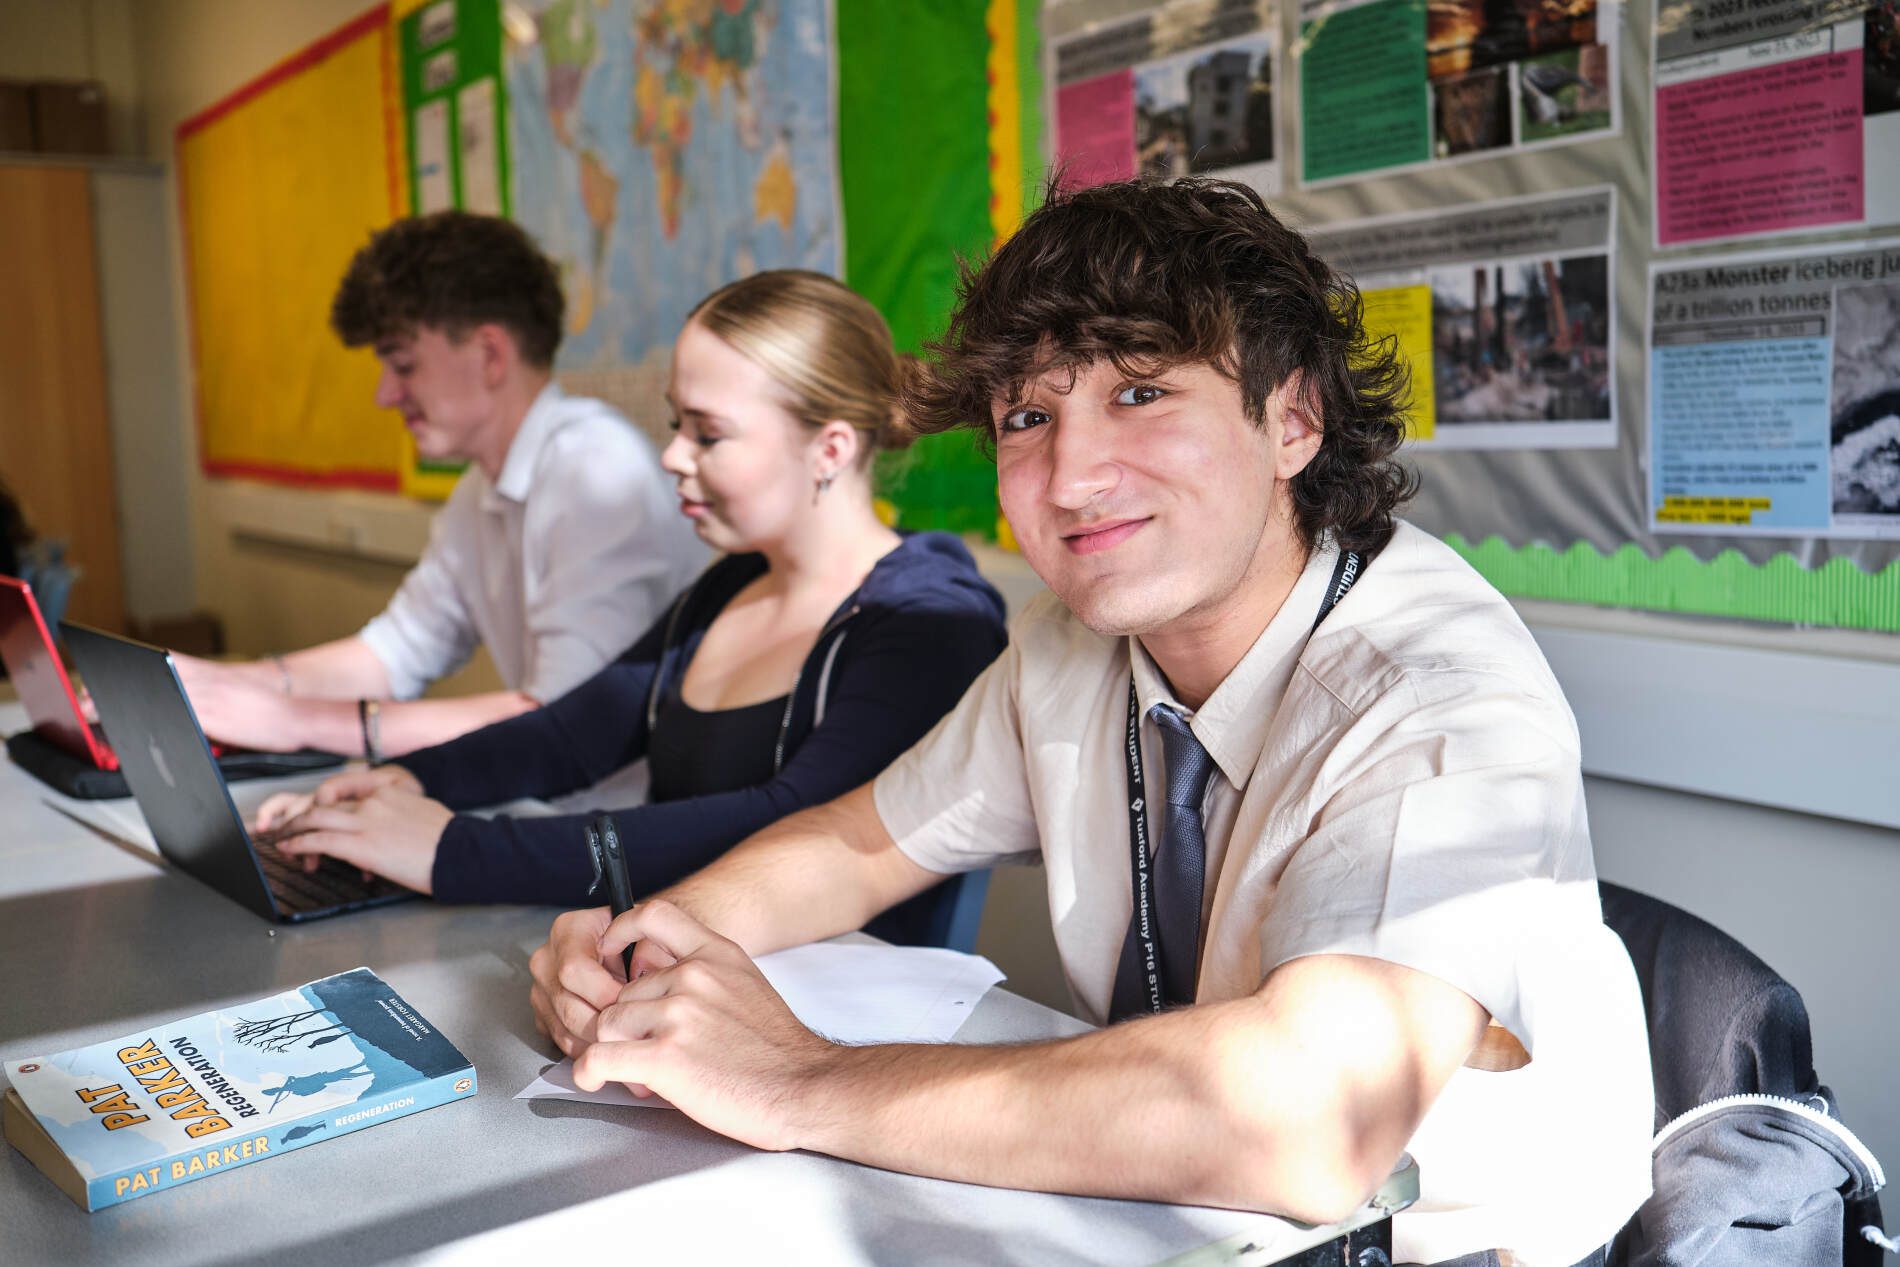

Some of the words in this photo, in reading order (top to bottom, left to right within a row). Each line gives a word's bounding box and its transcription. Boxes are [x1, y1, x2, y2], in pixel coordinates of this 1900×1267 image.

[1704, 264, 1791, 289] Monster
[1759, 290, 1832, 313] tonnes
[1136, 815, 1147, 869] Tuxford
[1138, 872, 1150, 939] Academy
[1144, 942, 1155, 971] P16
[388, 998, 409, 1015] FORSTER
[406, 1014, 430, 1034] MARGARET
[116, 1037, 234, 1139] BARKER
[169, 1036, 261, 1119] REGENERATION
[75, 1083, 152, 1132] PAT
[114, 1166, 162, 1197] PAT
[171, 1135, 271, 1180] BARKER
[335, 1096, 415, 1128] REGENERATION
